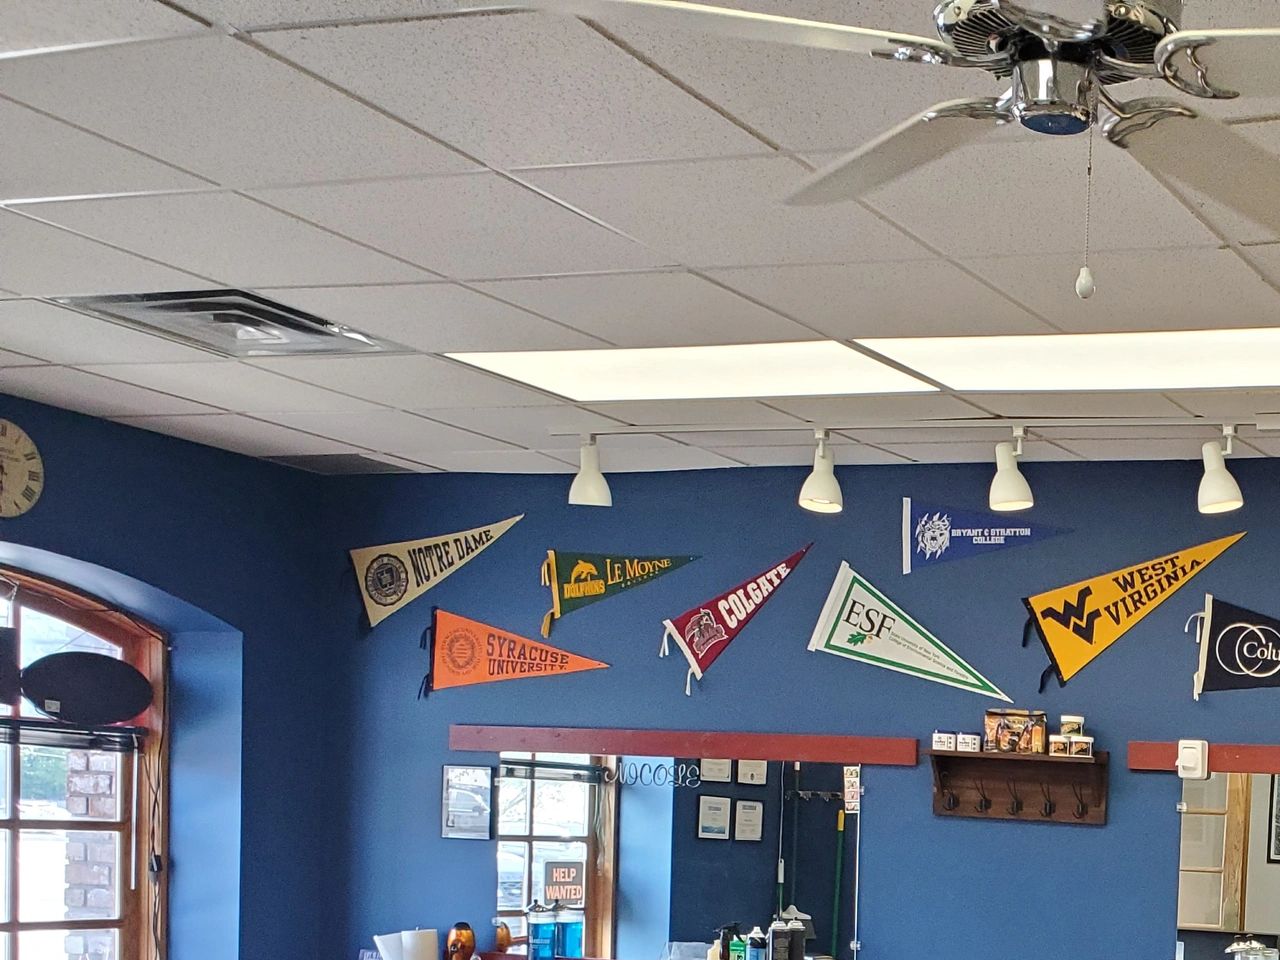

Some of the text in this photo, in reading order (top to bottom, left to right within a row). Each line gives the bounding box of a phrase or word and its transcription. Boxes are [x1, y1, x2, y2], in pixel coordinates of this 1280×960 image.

[991, 528, 1030, 536] STRATTON
[408, 541, 454, 587] NOTRE
[453, 530, 493, 561] DAME
[1112, 556, 1180, 593] WEST
[718, 563, 791, 629] COLGATE
[1104, 560, 1203, 626] VIRGINIA
[843, 599, 895, 639] ESF
[487, 633, 569, 664] SYRACUSE
[488, 659, 566, 675] UNIVERSITY
[604, 762, 700, 788] NICOLE
[553, 868, 576, 882] HELP
[546, 885, 582, 900] WANTED
